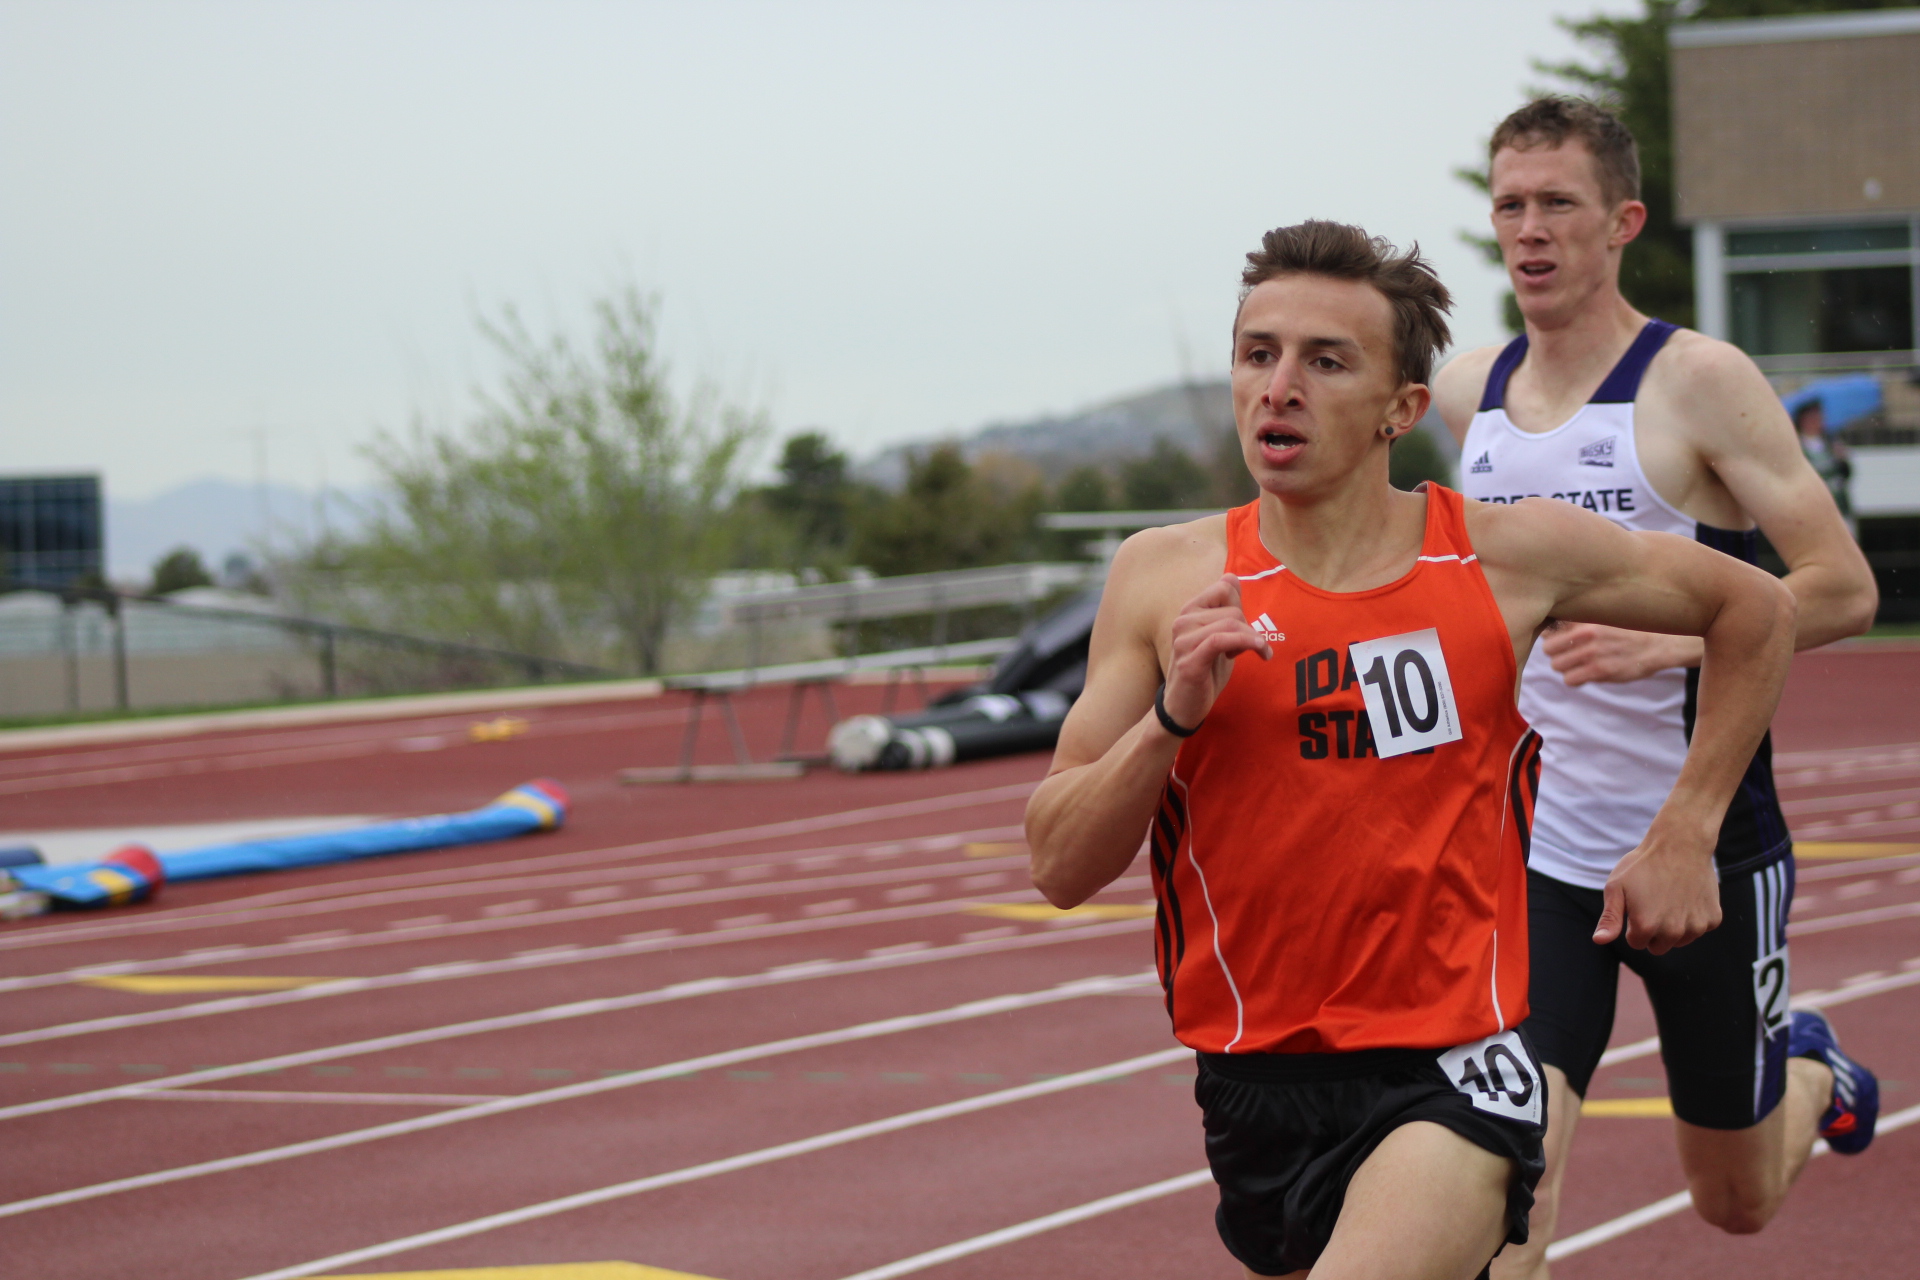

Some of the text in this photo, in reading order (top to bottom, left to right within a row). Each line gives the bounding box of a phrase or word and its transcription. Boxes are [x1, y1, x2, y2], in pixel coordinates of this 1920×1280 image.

[1261, 630, 1286, 642] das
[1295, 641, 1360, 707] IDA
[1362, 648, 1440, 739] 10
[1298, 708, 1435, 760] STA
[1758, 957, 1785, 1028] 2
[1458, 1043, 1534, 1108] 10
